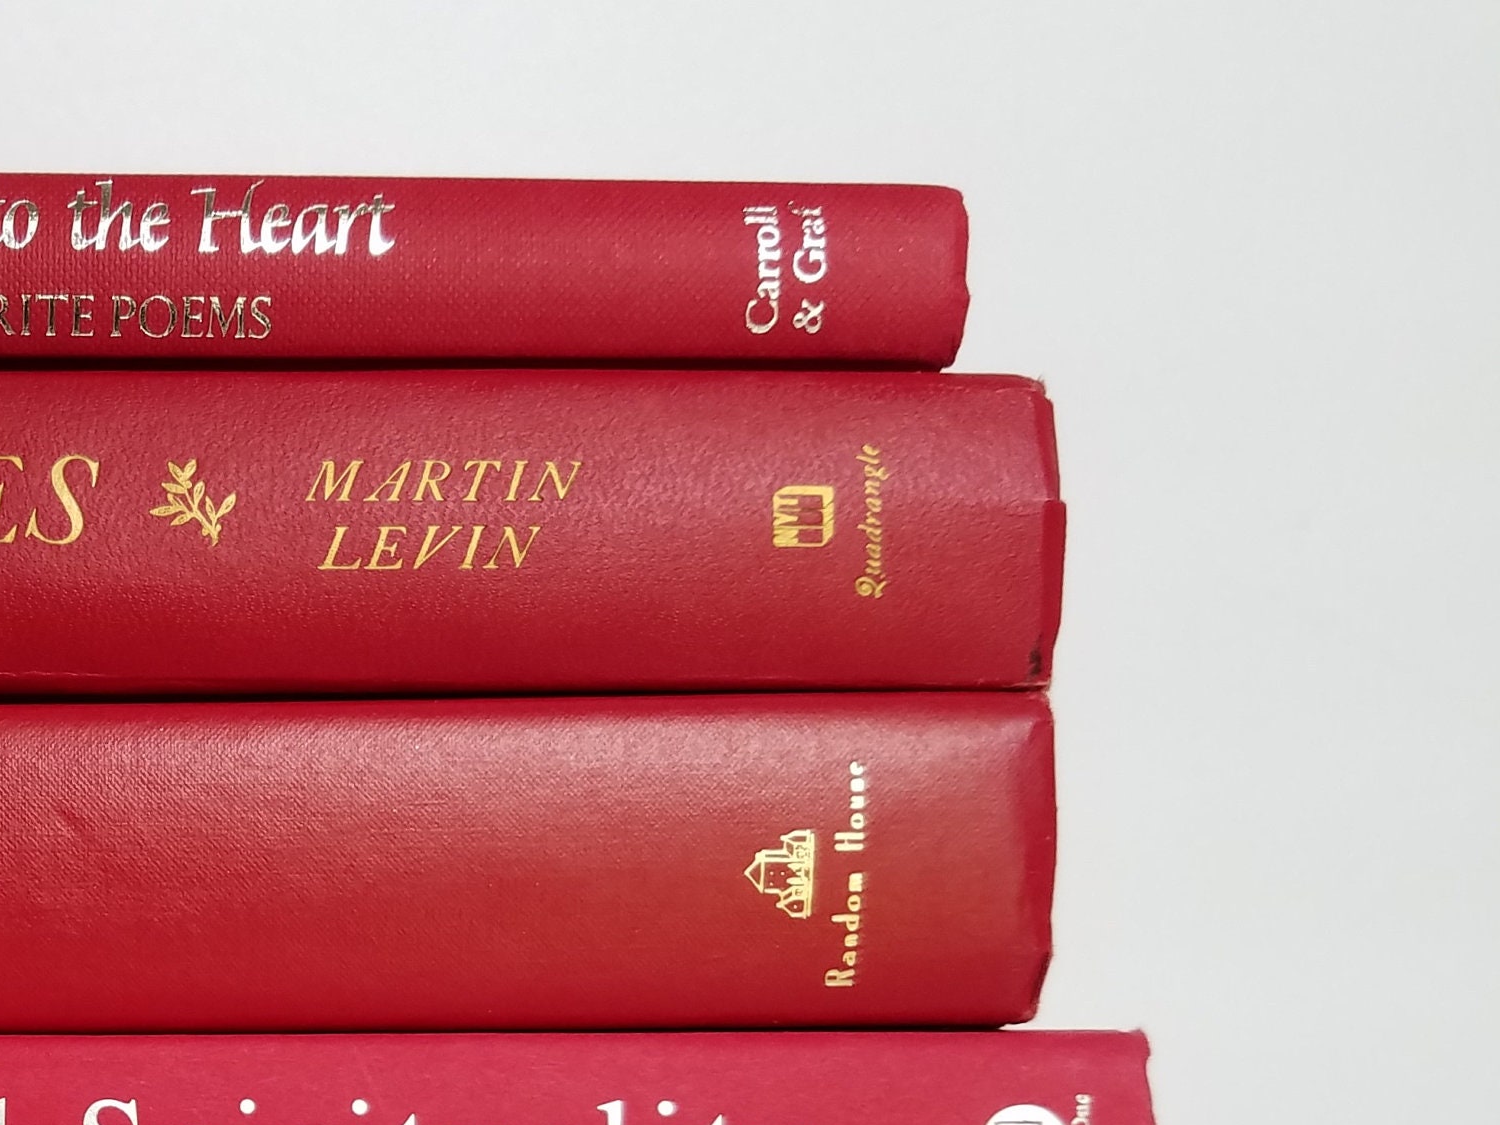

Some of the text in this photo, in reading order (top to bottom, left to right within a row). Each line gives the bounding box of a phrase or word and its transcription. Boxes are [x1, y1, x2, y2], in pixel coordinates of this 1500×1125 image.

[67, 179, 171, 253] the
[190, 179, 396, 257] Heart
[743, 205, 781, 335] Carroll
[109, 295, 273, 342] POEMS
[792, 299, 825, 335] &
[305, 459, 583, 503] MARTIN
[316, 525, 543, 572] LEVIN
[854, 443, 891, 599] Quadrangle
[824, 872, 863, 987] Random
